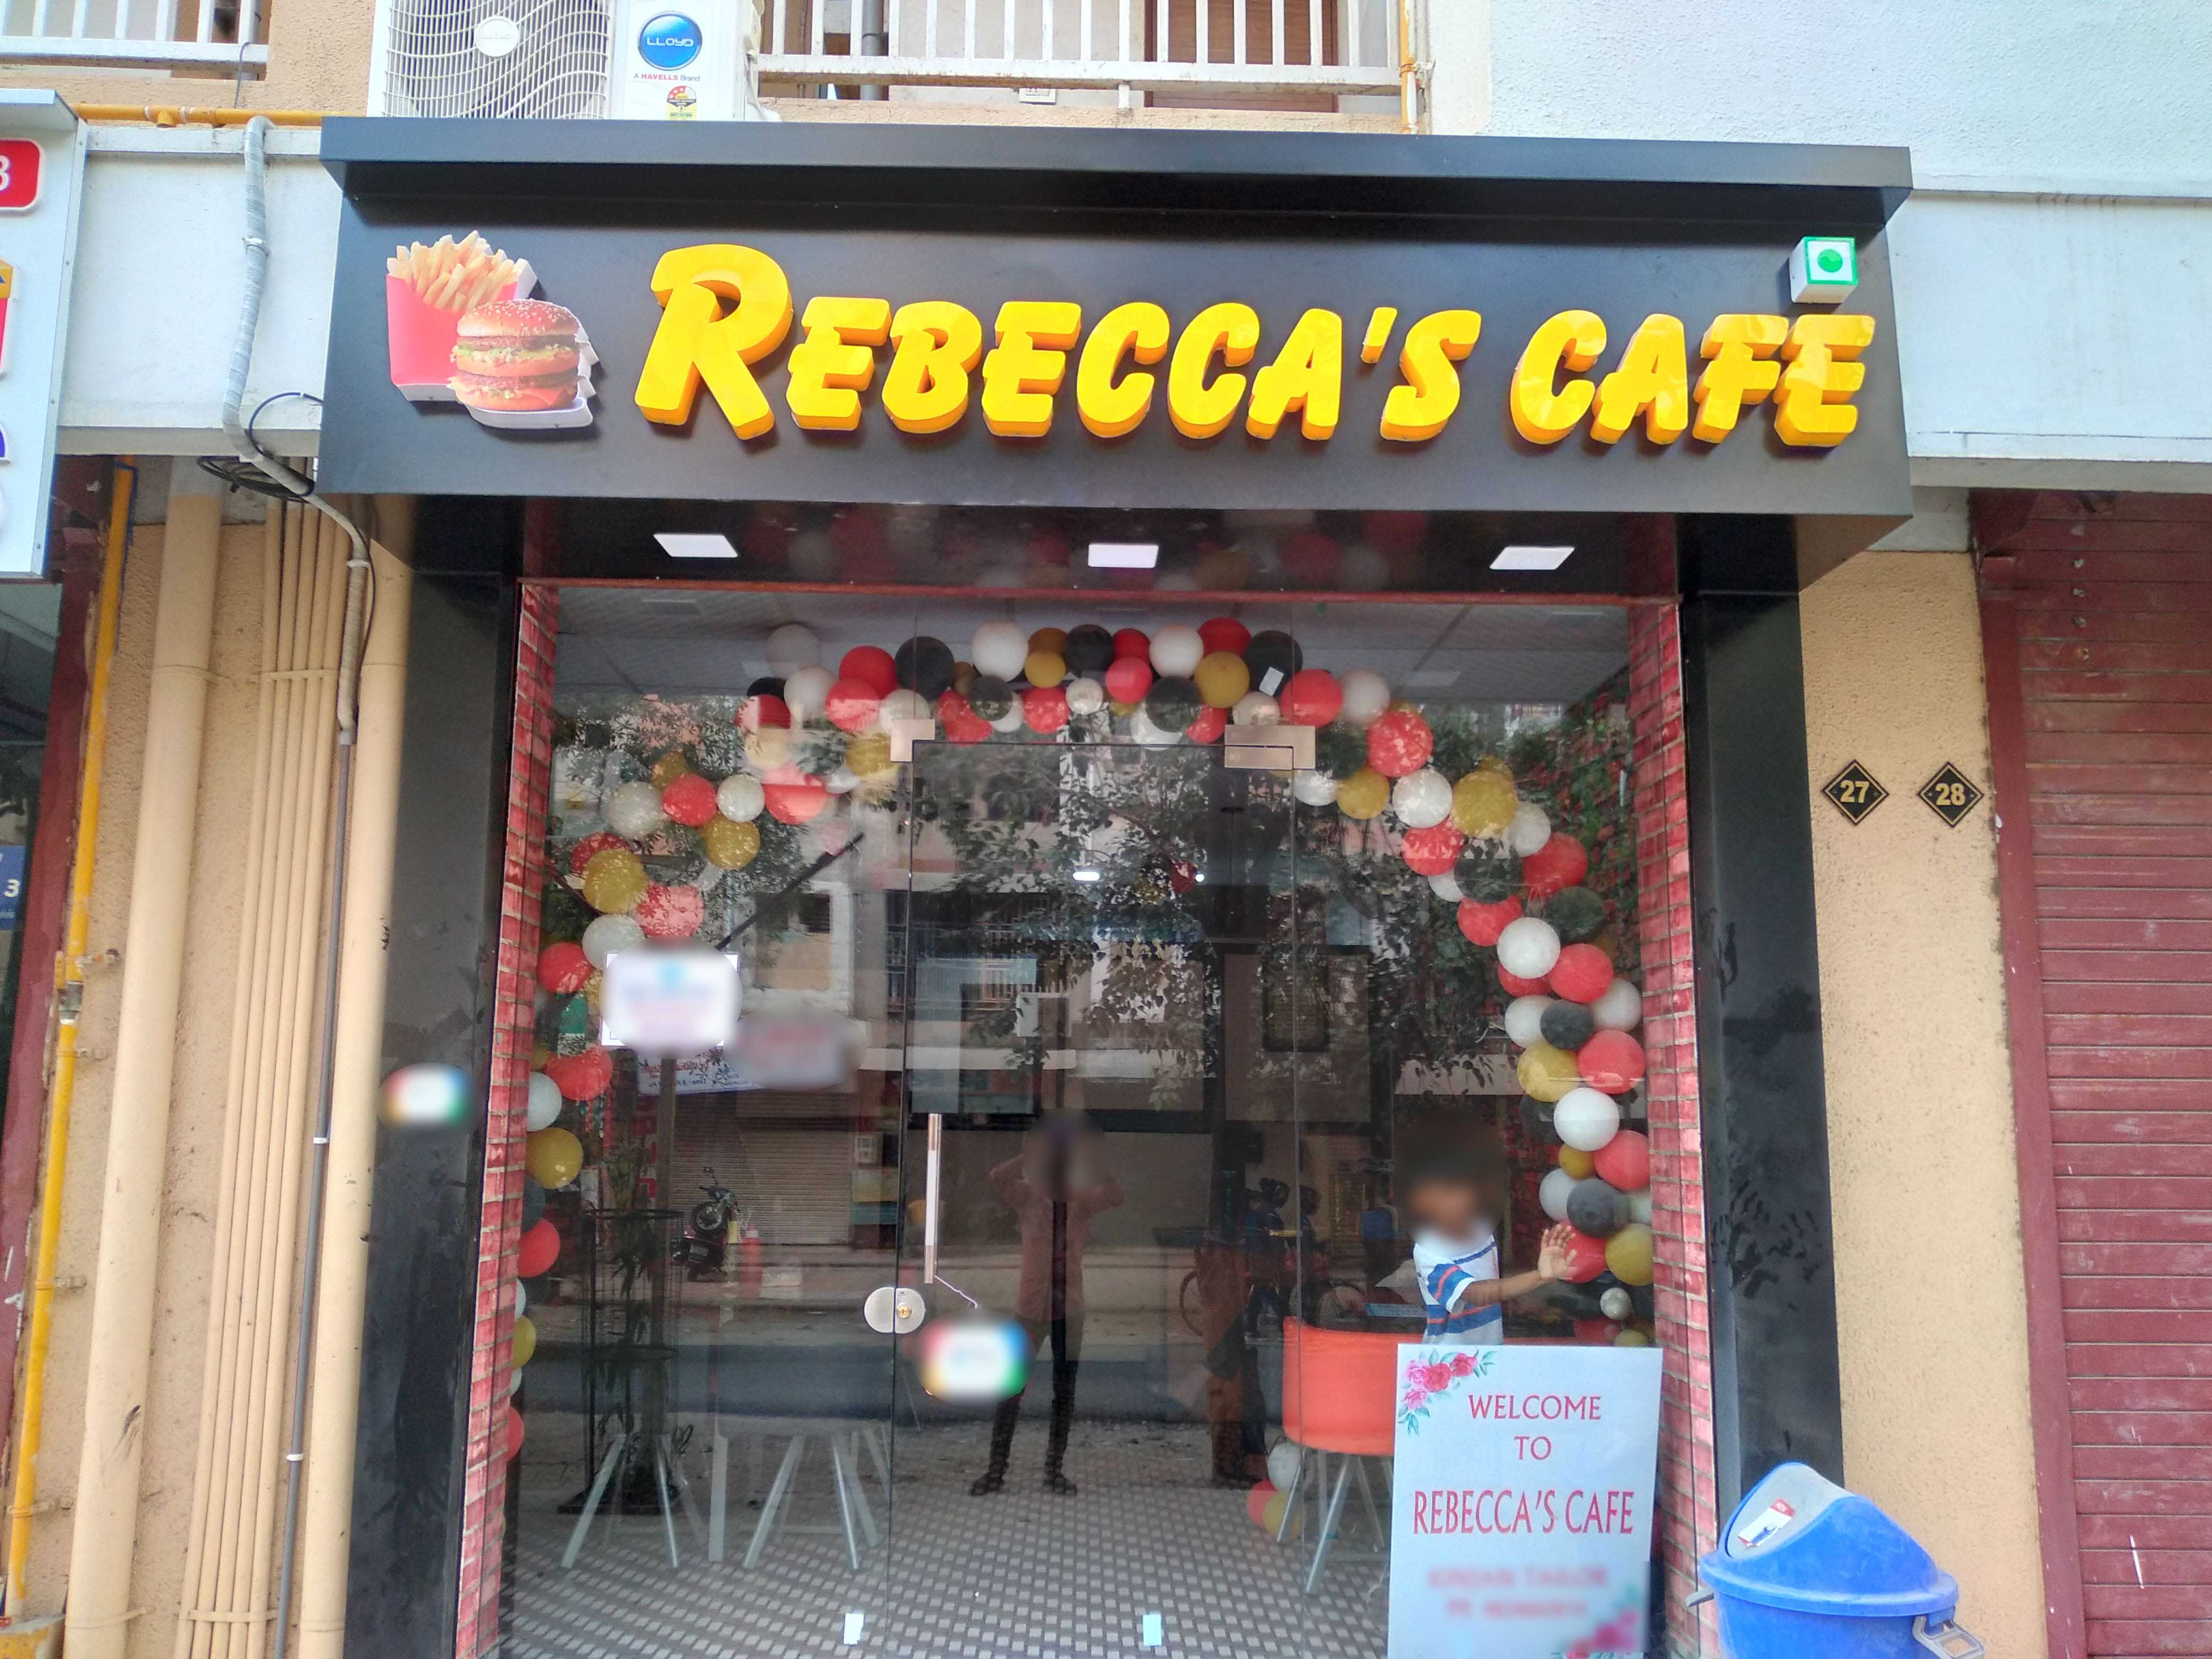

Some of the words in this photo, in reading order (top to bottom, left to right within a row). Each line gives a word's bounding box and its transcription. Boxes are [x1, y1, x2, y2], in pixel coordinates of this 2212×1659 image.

[647, 37, 694, 46] LLOYD
[635, 243, 1481, 441] REBECCA'S
[1510, 309, 1876, 447] CAFE
[1840, 780, 1870, 803] 27
[1935, 783, 1965, 806] 28
[1468, 1395, 1602, 1420] WELCOME
[1514, 1436, 1552, 1460] TO
[1413, 1490, 1556, 1534] REBECCA'S
[1565, 1490, 1635, 1534] CAFE
